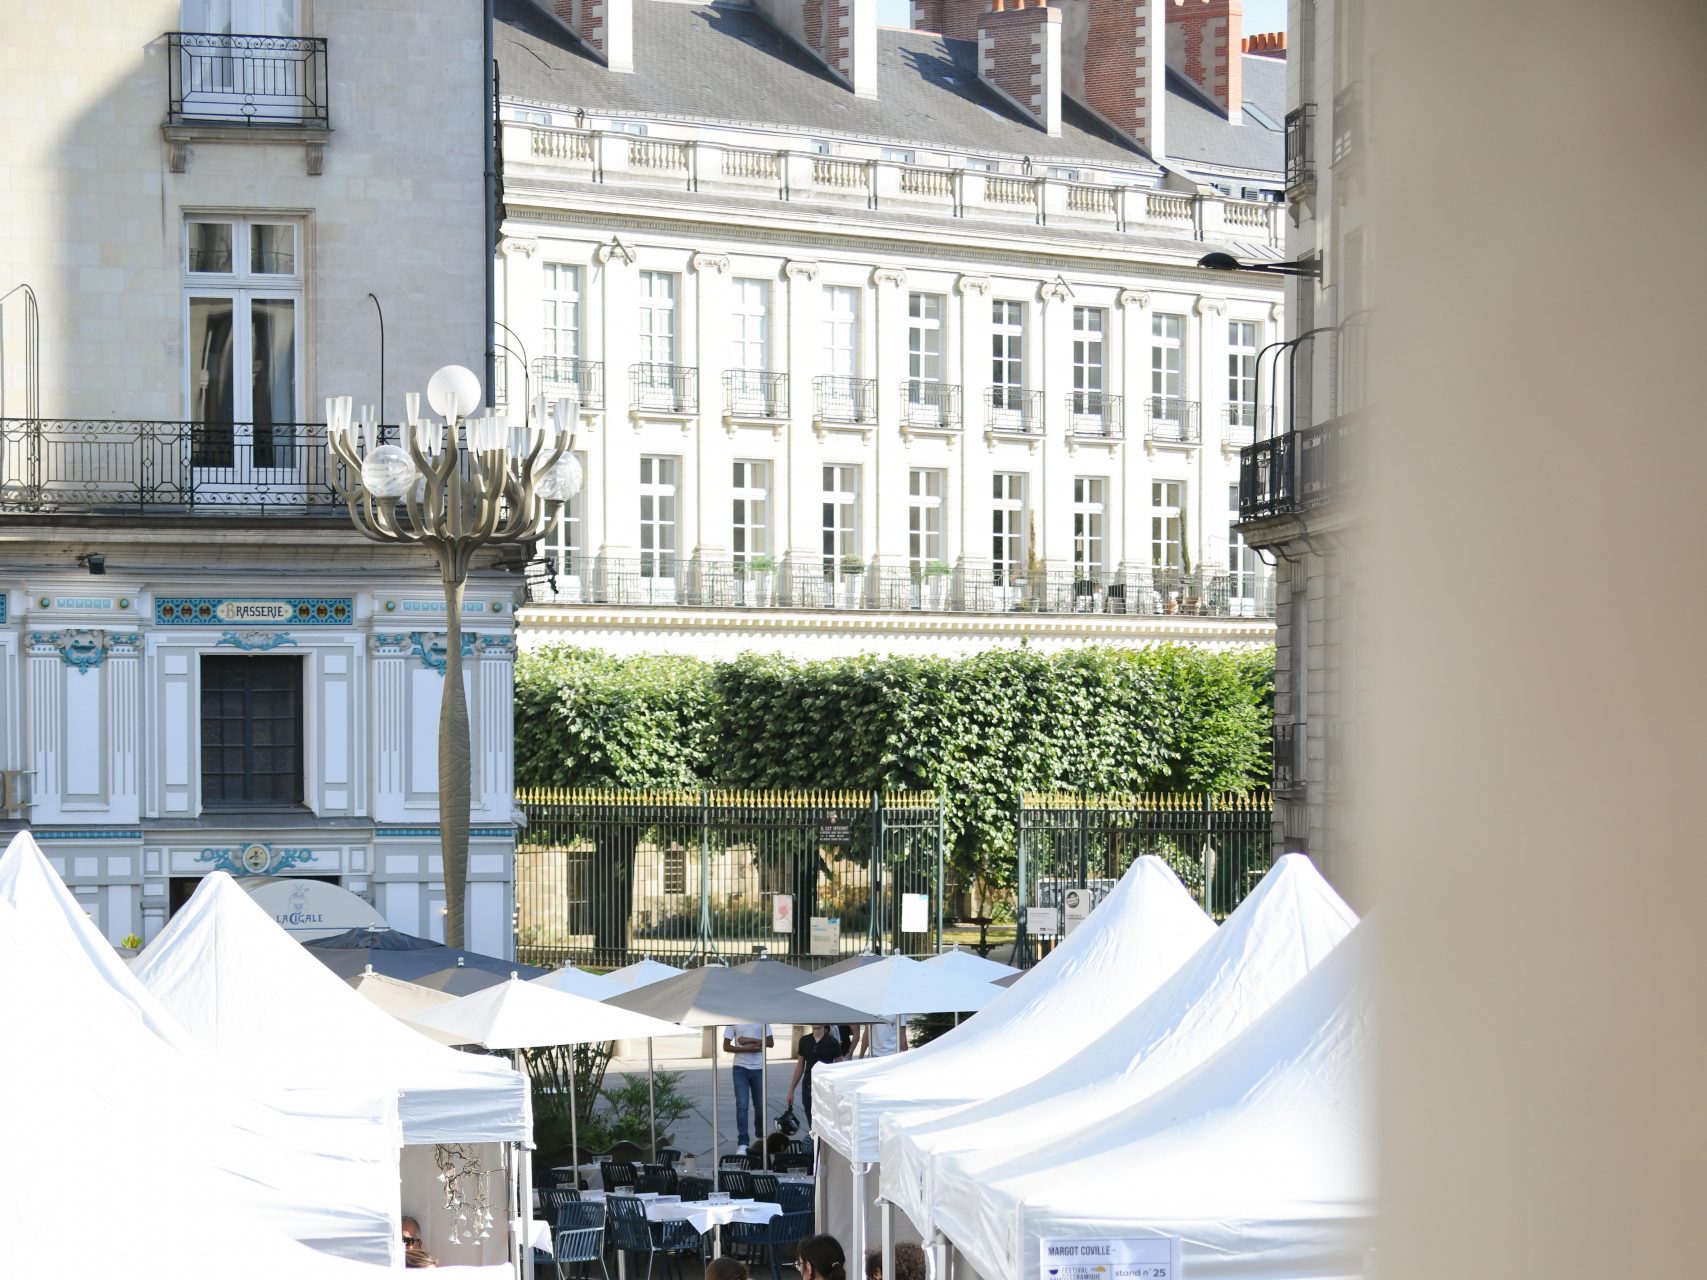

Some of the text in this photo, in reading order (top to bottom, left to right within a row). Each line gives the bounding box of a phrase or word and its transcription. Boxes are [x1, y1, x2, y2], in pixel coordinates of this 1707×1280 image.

[225, 603, 284, 619] BRASSERIE
[1048, 1245, 1111, 1256] MARGOT COVILLE
[1115, 1268, 1141, 1277] stand
[1153, 1268, 1166, 1277] 25
